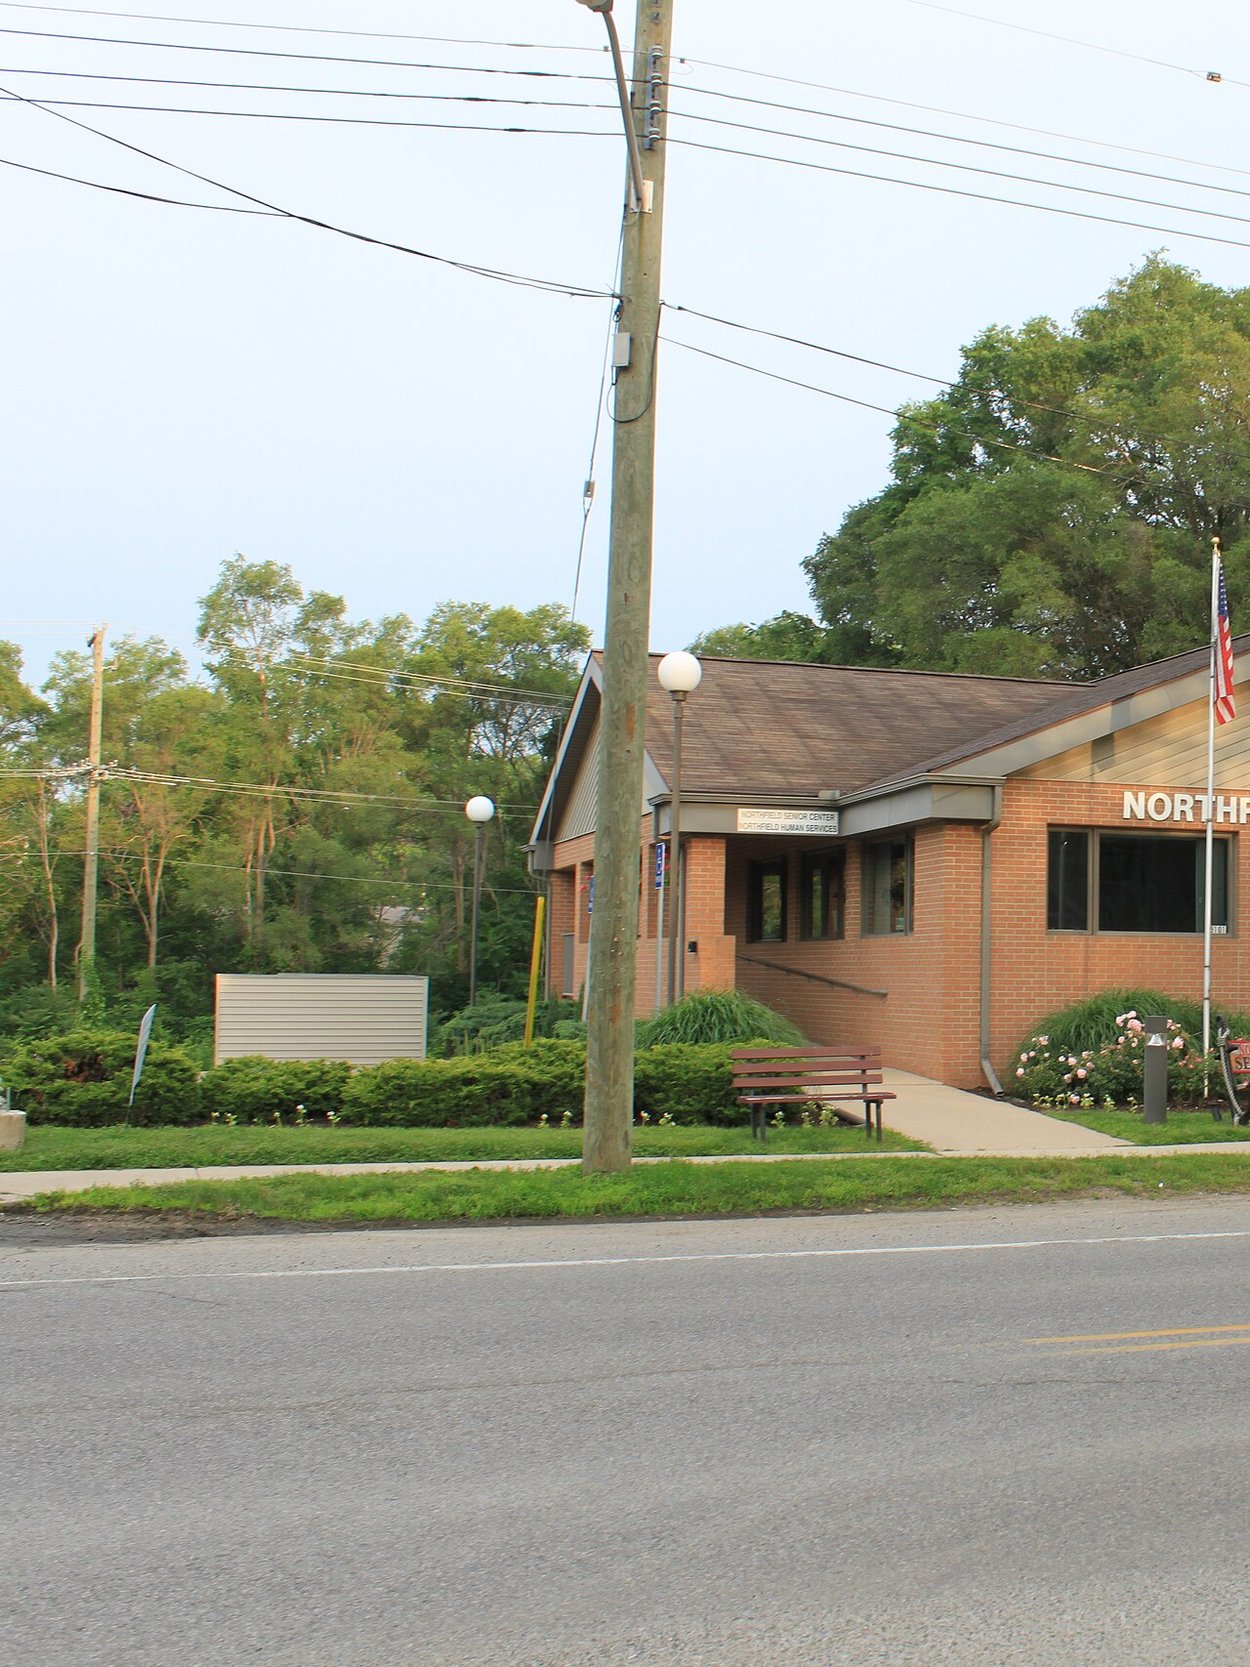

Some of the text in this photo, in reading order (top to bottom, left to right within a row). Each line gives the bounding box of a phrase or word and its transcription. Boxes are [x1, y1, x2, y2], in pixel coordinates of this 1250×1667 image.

[783, 812, 807, 820] SENIOR
[809, 812, 834, 821] CENTER
[781, 823, 804, 832] HUMAN
[806, 824, 837, 833] SERVICES
